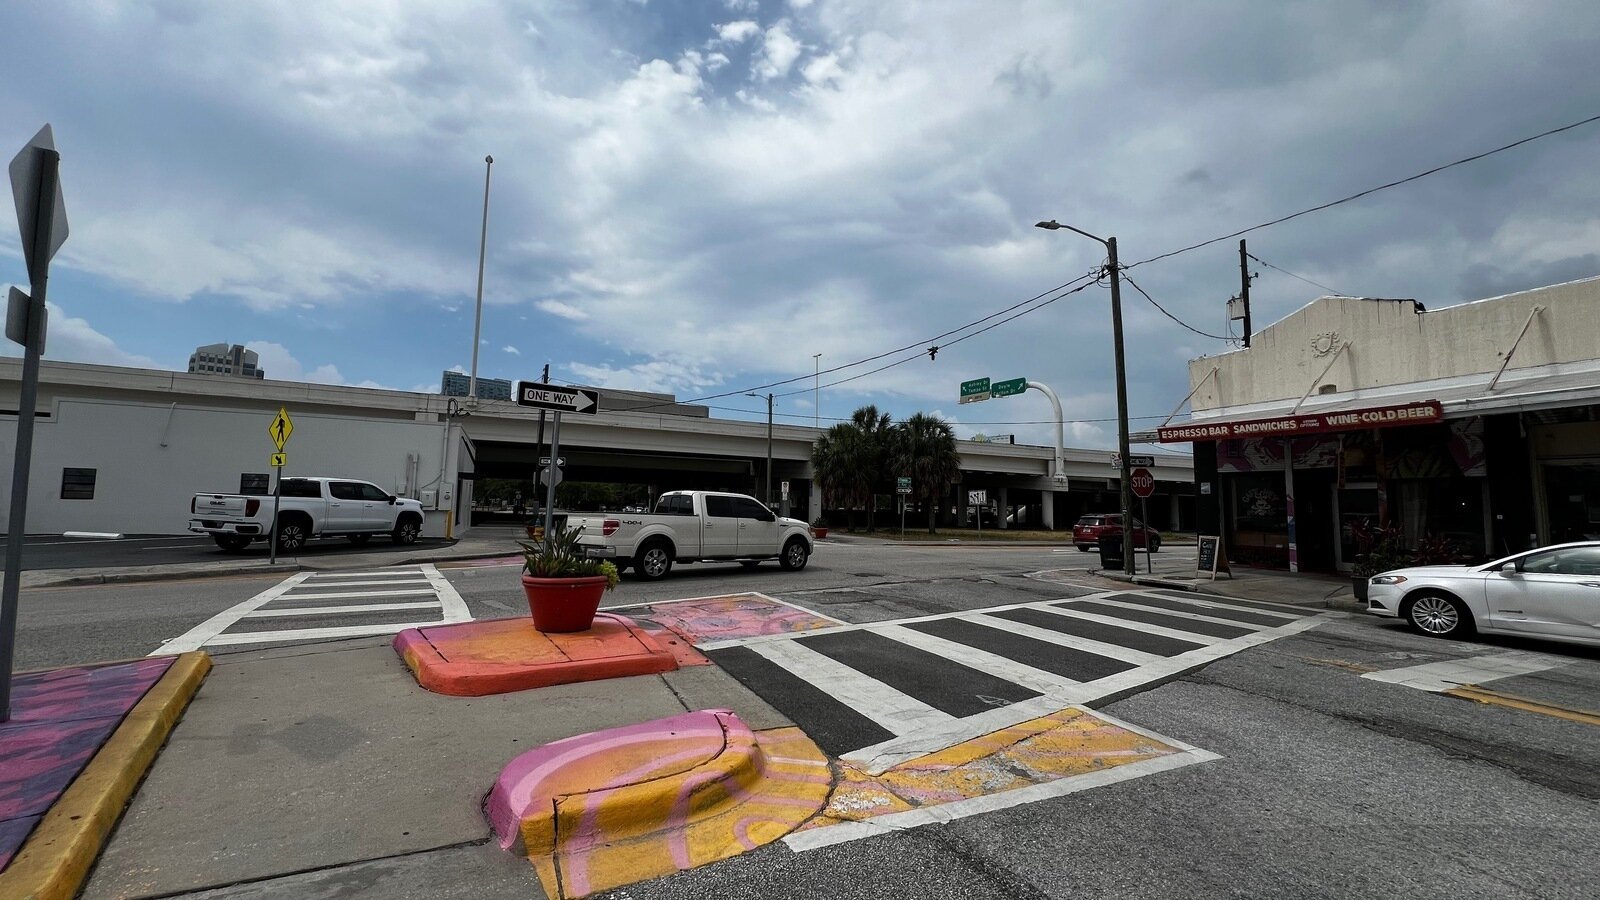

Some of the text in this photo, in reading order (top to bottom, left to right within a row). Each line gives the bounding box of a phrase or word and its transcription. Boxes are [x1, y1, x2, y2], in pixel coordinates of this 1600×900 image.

[527, 390, 575, 404] ONE WAY
[1397, 406, 1434, 419] BEER
[1161, 420, 1297, 439] ESPRESSO BAR SANDWICHES
[1132, 476, 1152, 488] STOP
